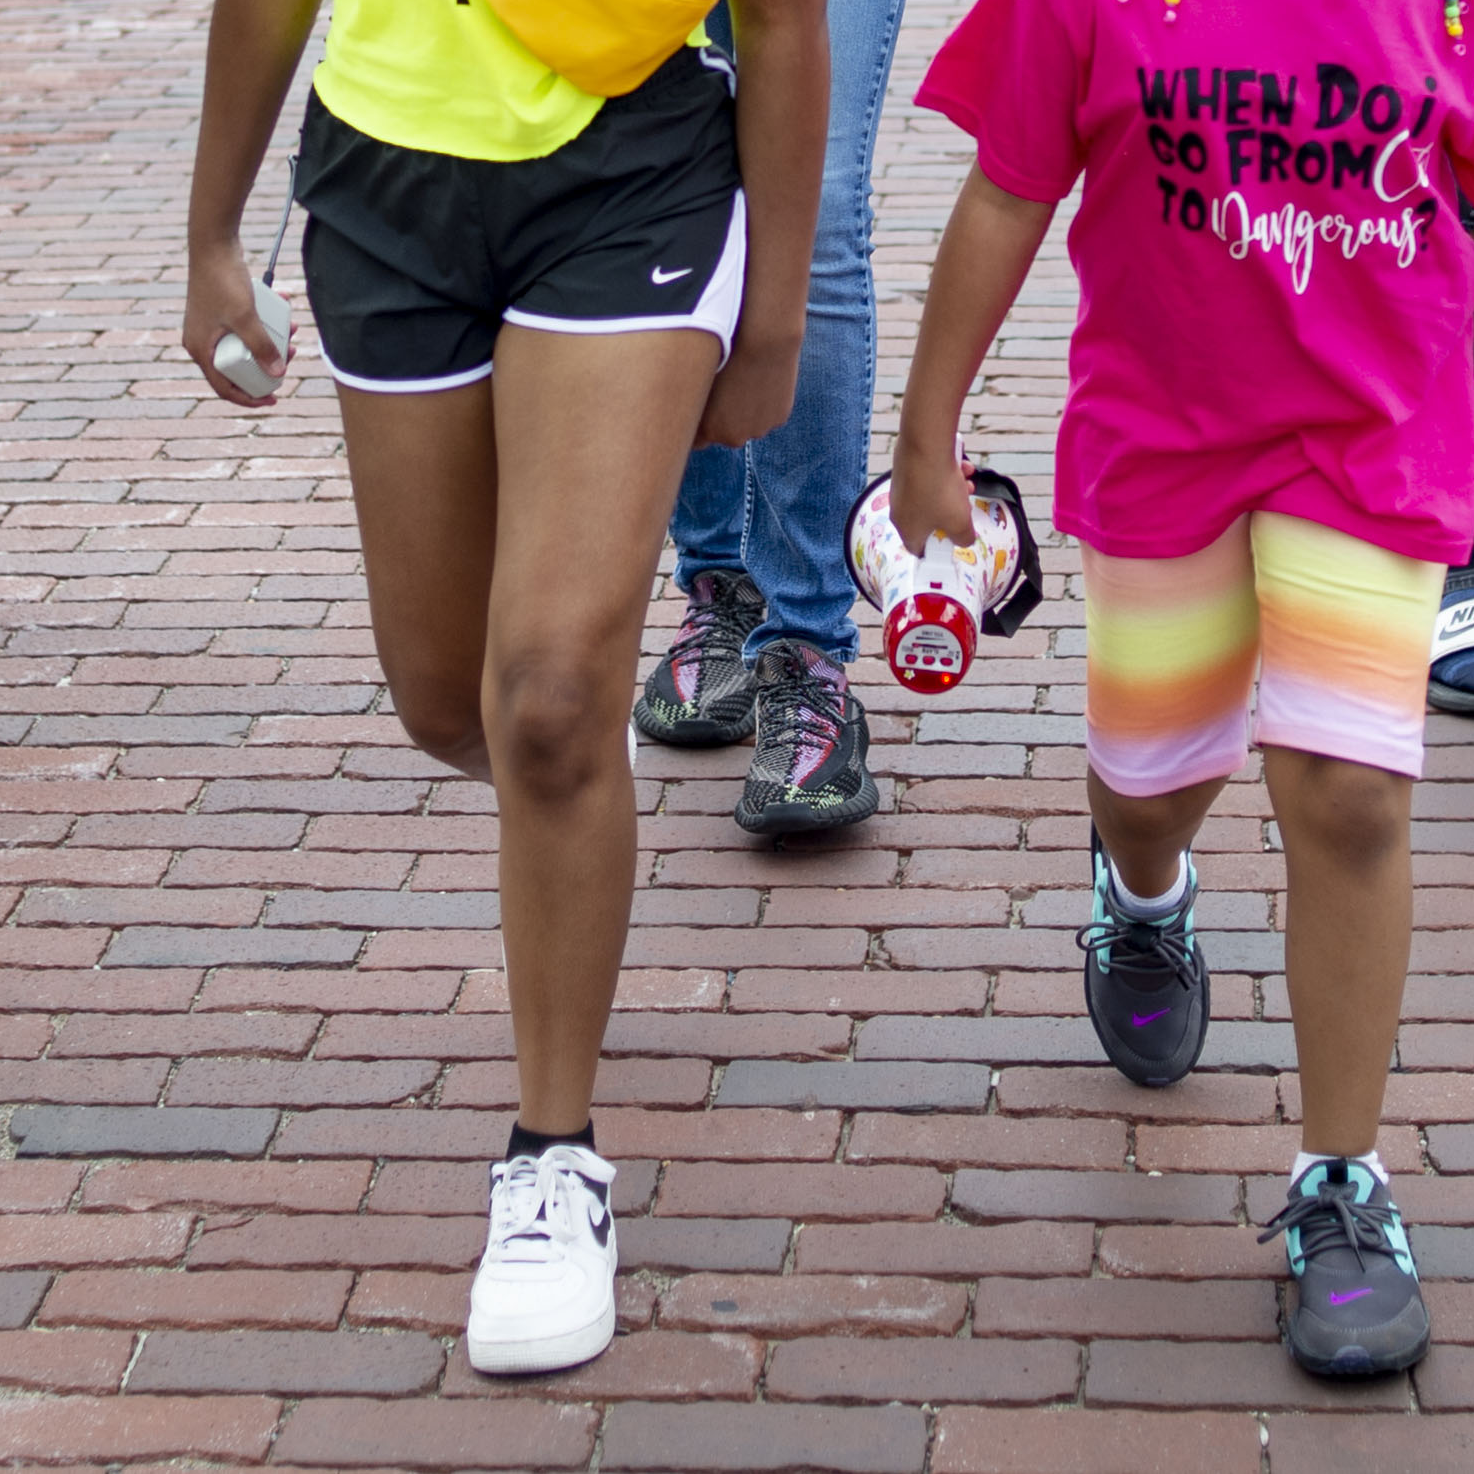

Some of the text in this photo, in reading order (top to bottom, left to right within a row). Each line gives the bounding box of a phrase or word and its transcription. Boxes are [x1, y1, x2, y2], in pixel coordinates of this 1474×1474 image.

[1137, 66, 1297, 126] WHEN
[1147, 123, 1207, 174] GO
[1226, 128, 1376, 190] FROM
[1157, 175, 1207, 232] TO
